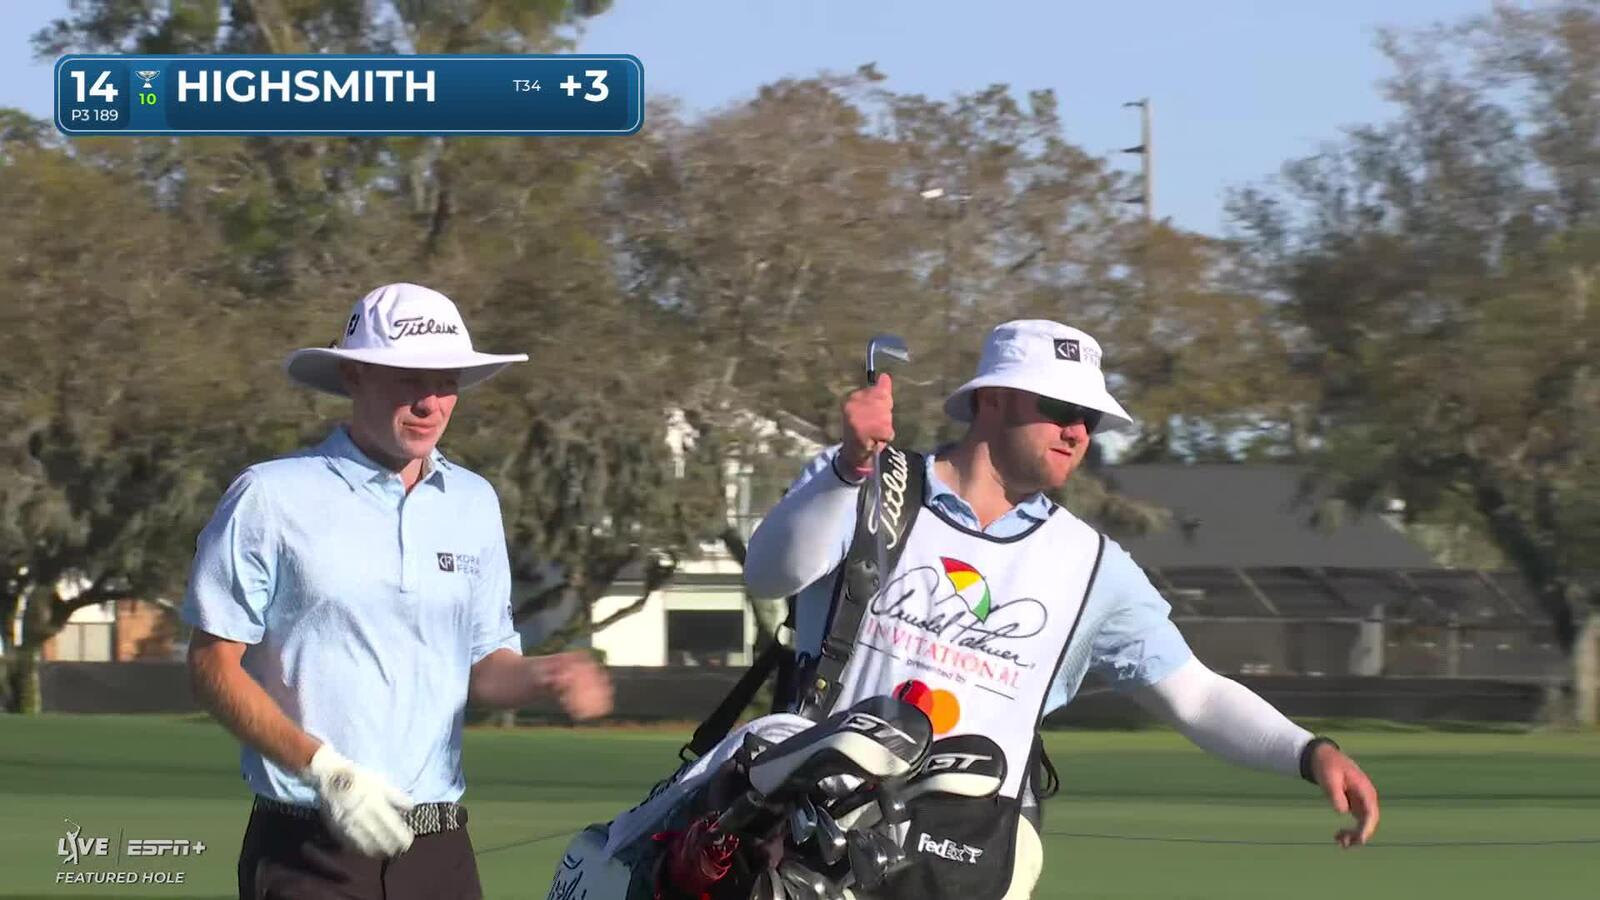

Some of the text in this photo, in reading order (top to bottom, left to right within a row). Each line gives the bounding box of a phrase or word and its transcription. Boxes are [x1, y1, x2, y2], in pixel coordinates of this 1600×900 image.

[388, 316, 459, 340] Titleist
[865, 617, 1022, 690] INVITATIONAL
[917, 832, 965, 863] FedEx
